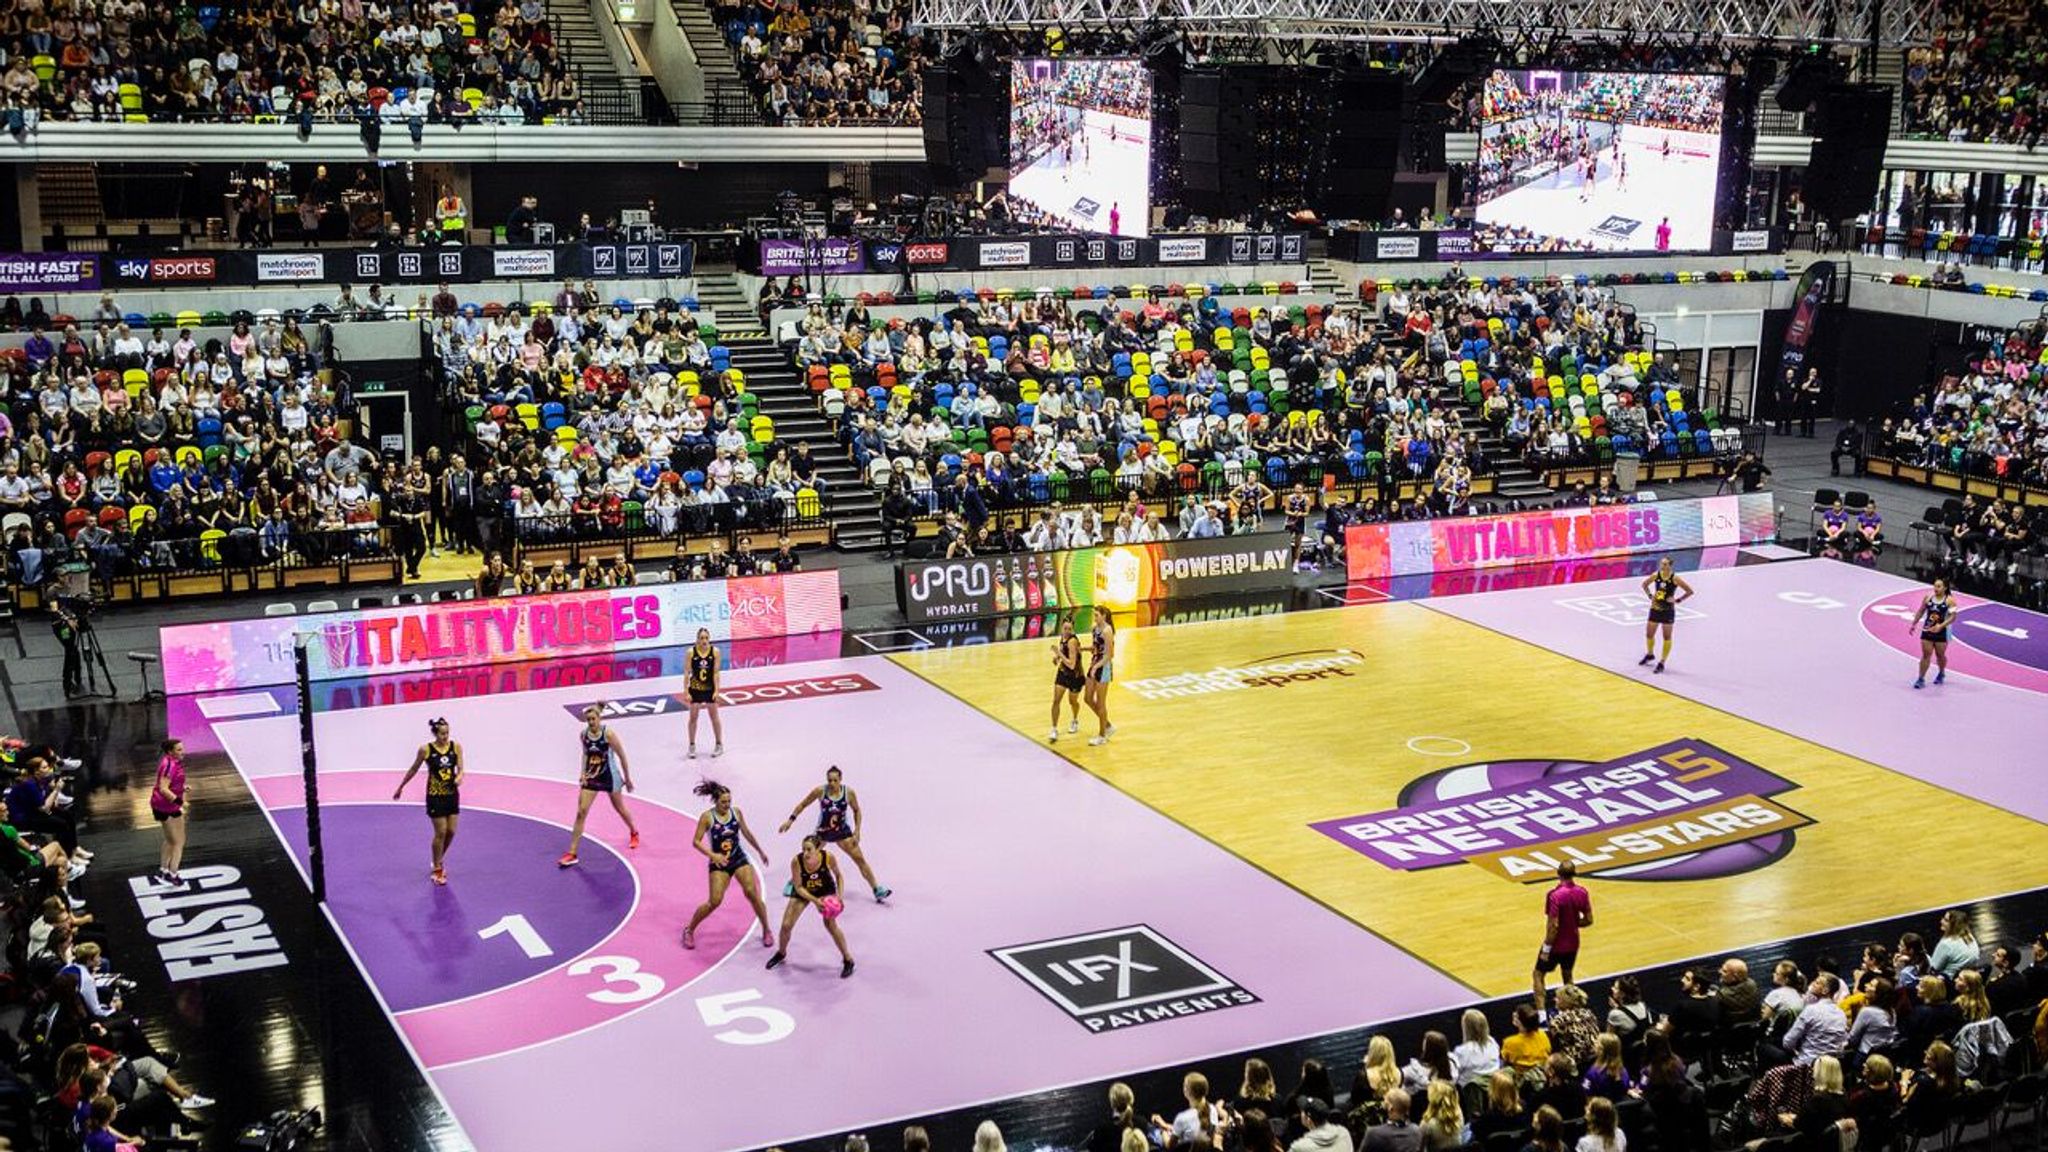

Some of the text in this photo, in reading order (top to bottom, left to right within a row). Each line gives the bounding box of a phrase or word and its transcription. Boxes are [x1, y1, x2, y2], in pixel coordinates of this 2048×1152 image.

[119, 260, 212, 279] sky sports
[260, 257, 317, 269] matchroom
[268, 268, 317, 279] multisport
[496, 253, 549, 265] matchroom
[503, 264, 548, 275] multisport
[876, 249, 899, 263] sky
[21, 274, 80, 284] ALL-STARS
[1446, 517, 1570, 564] VITALITY
[1574, 509, 1660, 552] ROSES
[1159, 548, 1290, 582] POWERPLAY
[926, 603, 979, 617] HYDRATE
[262, 594, 779, 667] TH VITALITY ROSES ARE BACK
[716, 674, 864, 706] ports
[1121, 654, 1366, 691] matchroom
[1139, 665, 1357, 701] multisport
[1338, 788, 1558, 841] BRITISH
[1369, 780, 1724, 862] NETBALL
[1497, 802, 1784, 878] ALL-STARS
[477, 914, 554, 959] 1
[566, 955, 667, 1004] 3
[1046, 939, 1160, 1000] IFX
[694, 988, 796, 1046] 5
[1083, 989, 1256, 1033] PAYMENTS
